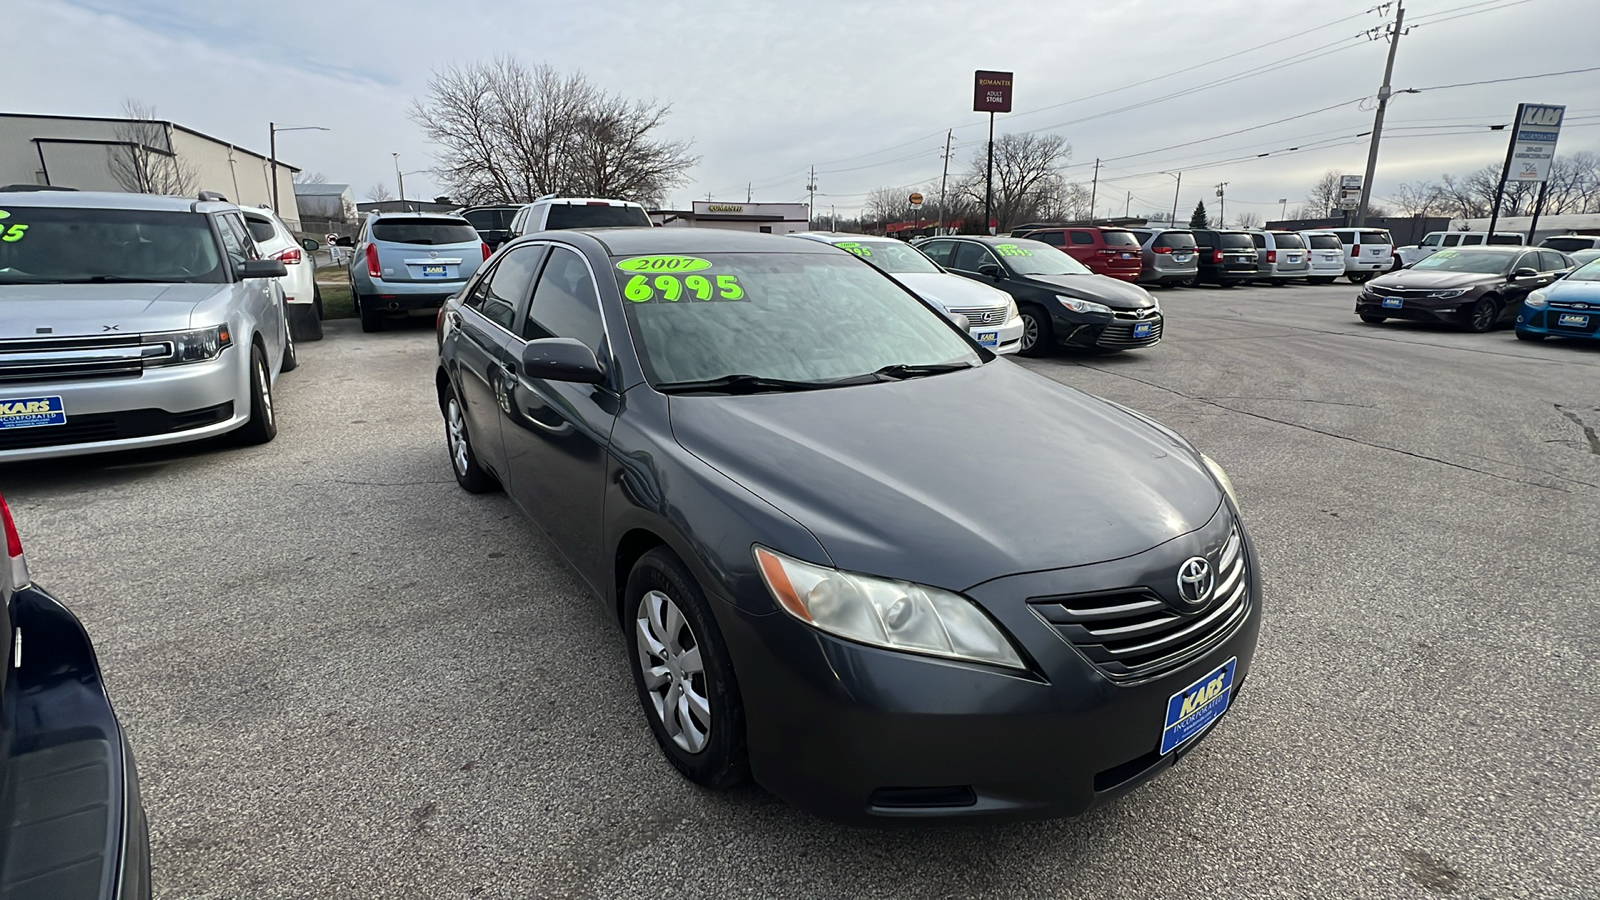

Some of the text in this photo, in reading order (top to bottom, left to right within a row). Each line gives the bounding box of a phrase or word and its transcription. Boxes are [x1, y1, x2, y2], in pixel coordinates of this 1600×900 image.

[978, 78, 1011, 87] ROMANTIX
[1522, 107, 1562, 126] KARS
[635, 258, 696, 270] 2007
[624, 274, 744, 302] 6995
[0, 400, 50, 415] KARS
[1179, 672, 1226, 719] KARS
[1173, 694, 1224, 733] INCORPORATED
